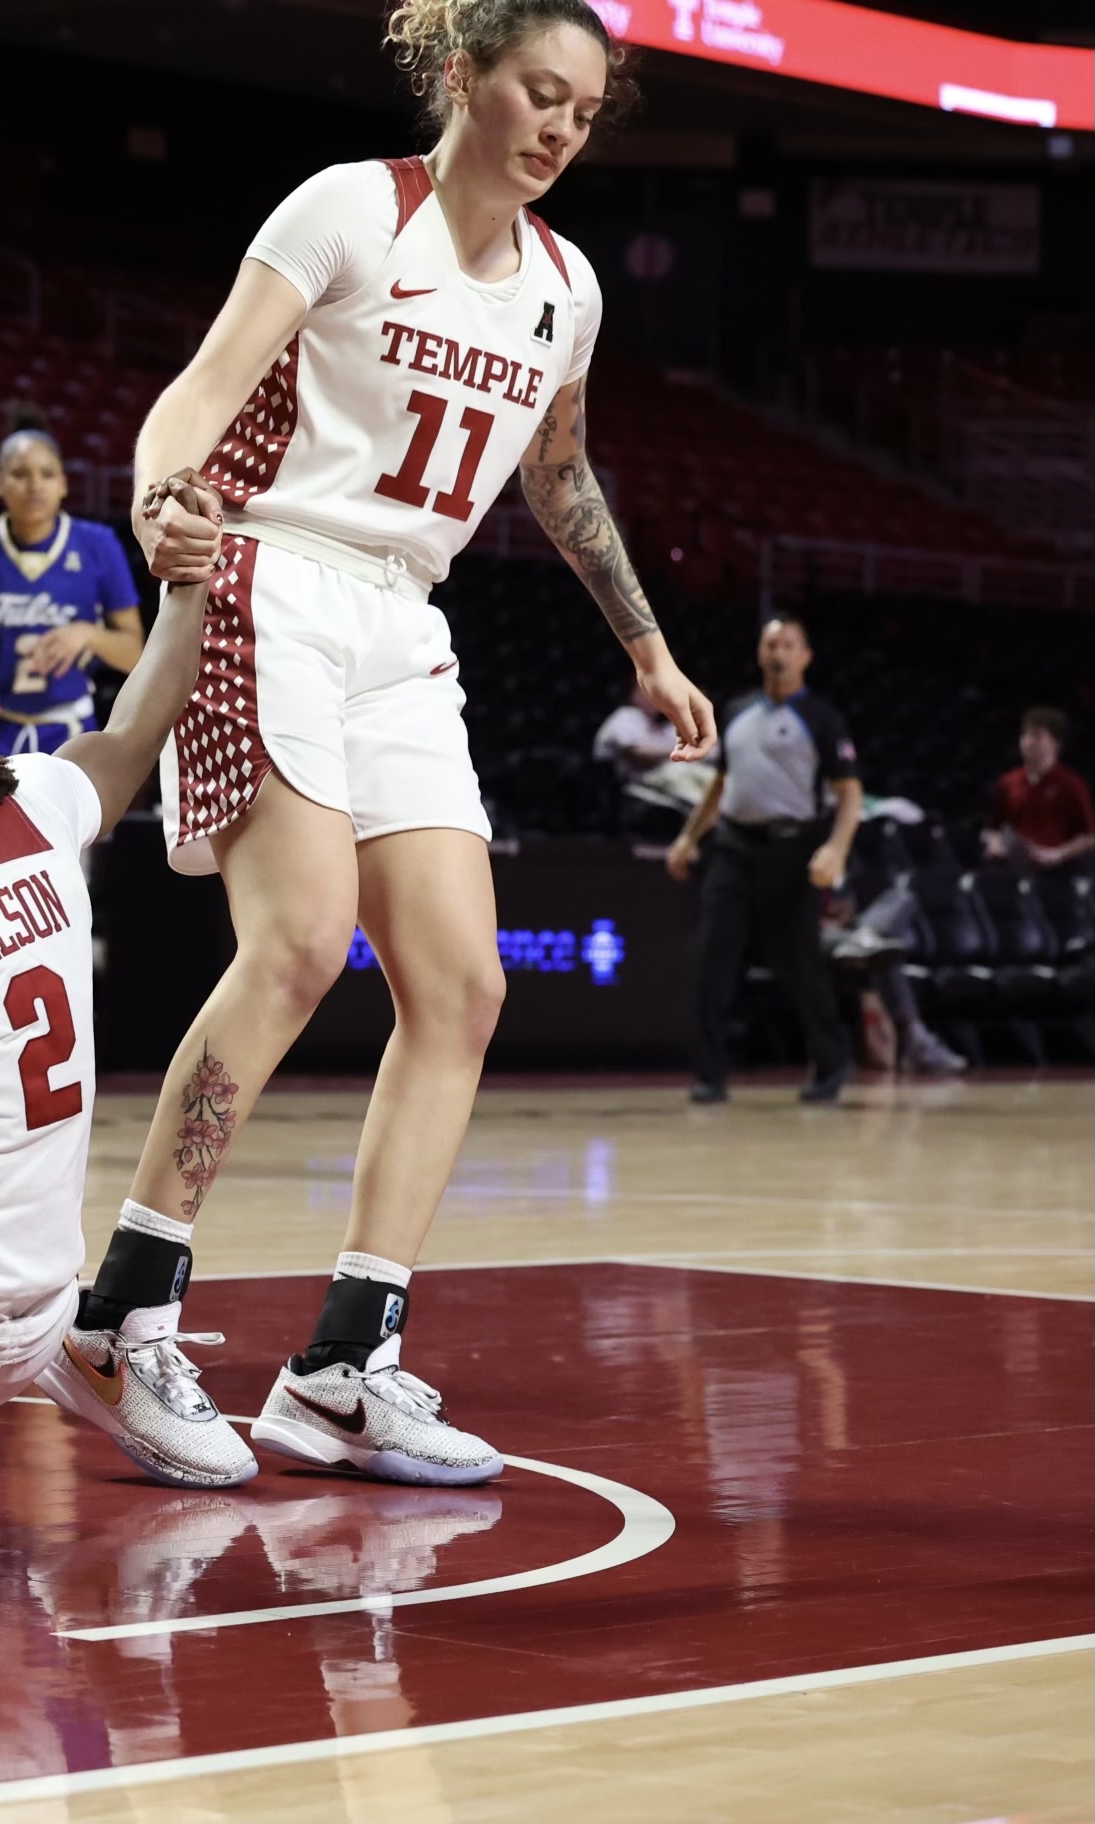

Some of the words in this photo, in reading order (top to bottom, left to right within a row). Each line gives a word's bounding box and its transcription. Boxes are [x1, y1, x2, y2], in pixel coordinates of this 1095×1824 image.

[380, 321, 545, 409] TEMPLE
[374, 389, 495, 523] 11
[3, 963, 84, 1132] 2
